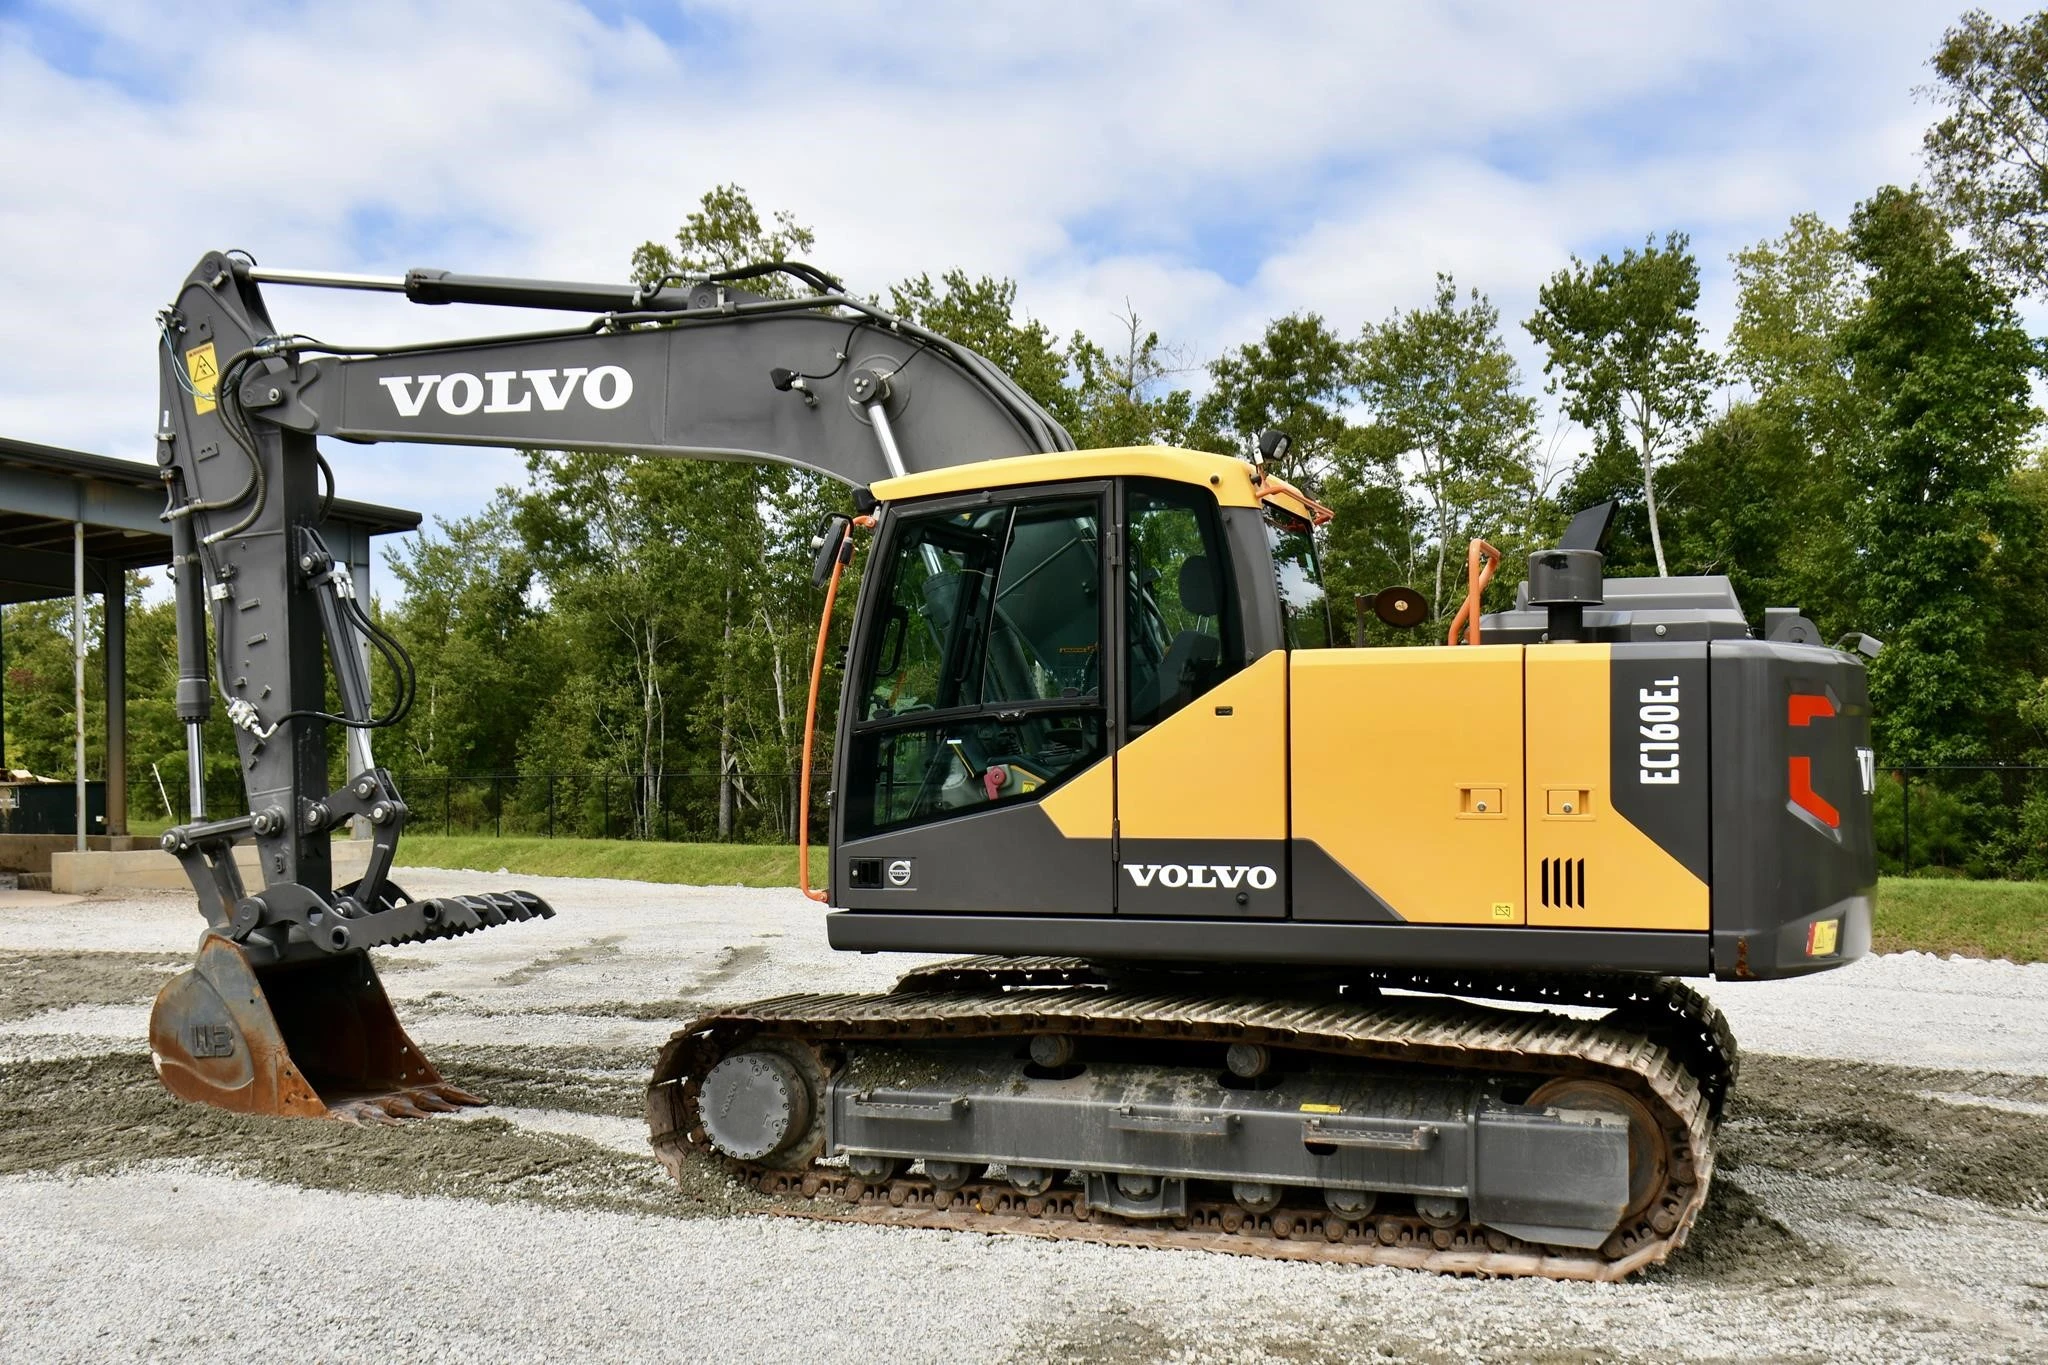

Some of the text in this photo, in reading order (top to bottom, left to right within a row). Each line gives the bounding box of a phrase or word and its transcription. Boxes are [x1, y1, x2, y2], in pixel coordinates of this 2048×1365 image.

[379, 365, 634, 416] VOLVO
[1639, 675, 1680, 785] EC160EL
[1123, 864, 1277, 890] VOLVO
